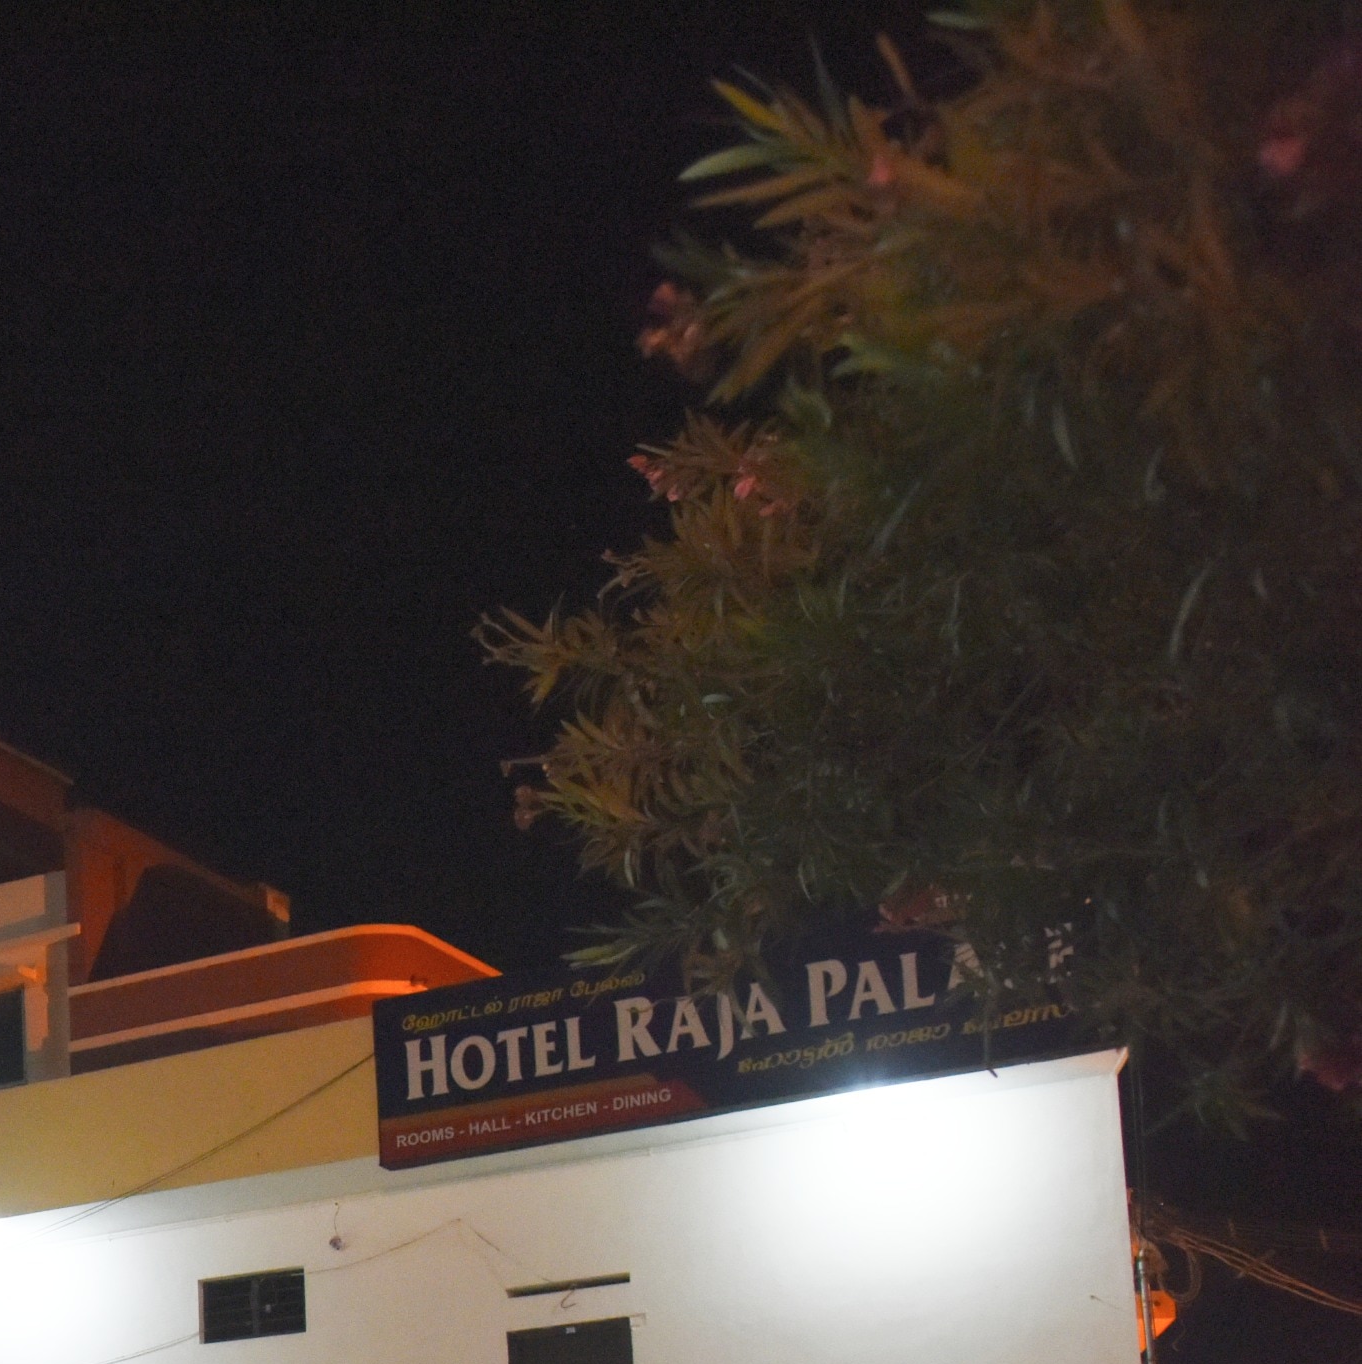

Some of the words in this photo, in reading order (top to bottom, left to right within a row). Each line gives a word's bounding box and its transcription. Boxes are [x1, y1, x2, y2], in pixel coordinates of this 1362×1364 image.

[404, 1015, 597, 1101] HOTEL
[613, 981, 788, 1061] RAJA
[804, 921, 1074, 1028] PALA
[396, 1126, 455, 1149] ROOMS
[469, 1116, 511, 1137] HALL
[525, 1101, 598, 1127] KITCHEN
[612, 1087, 672, 1112] DINING
